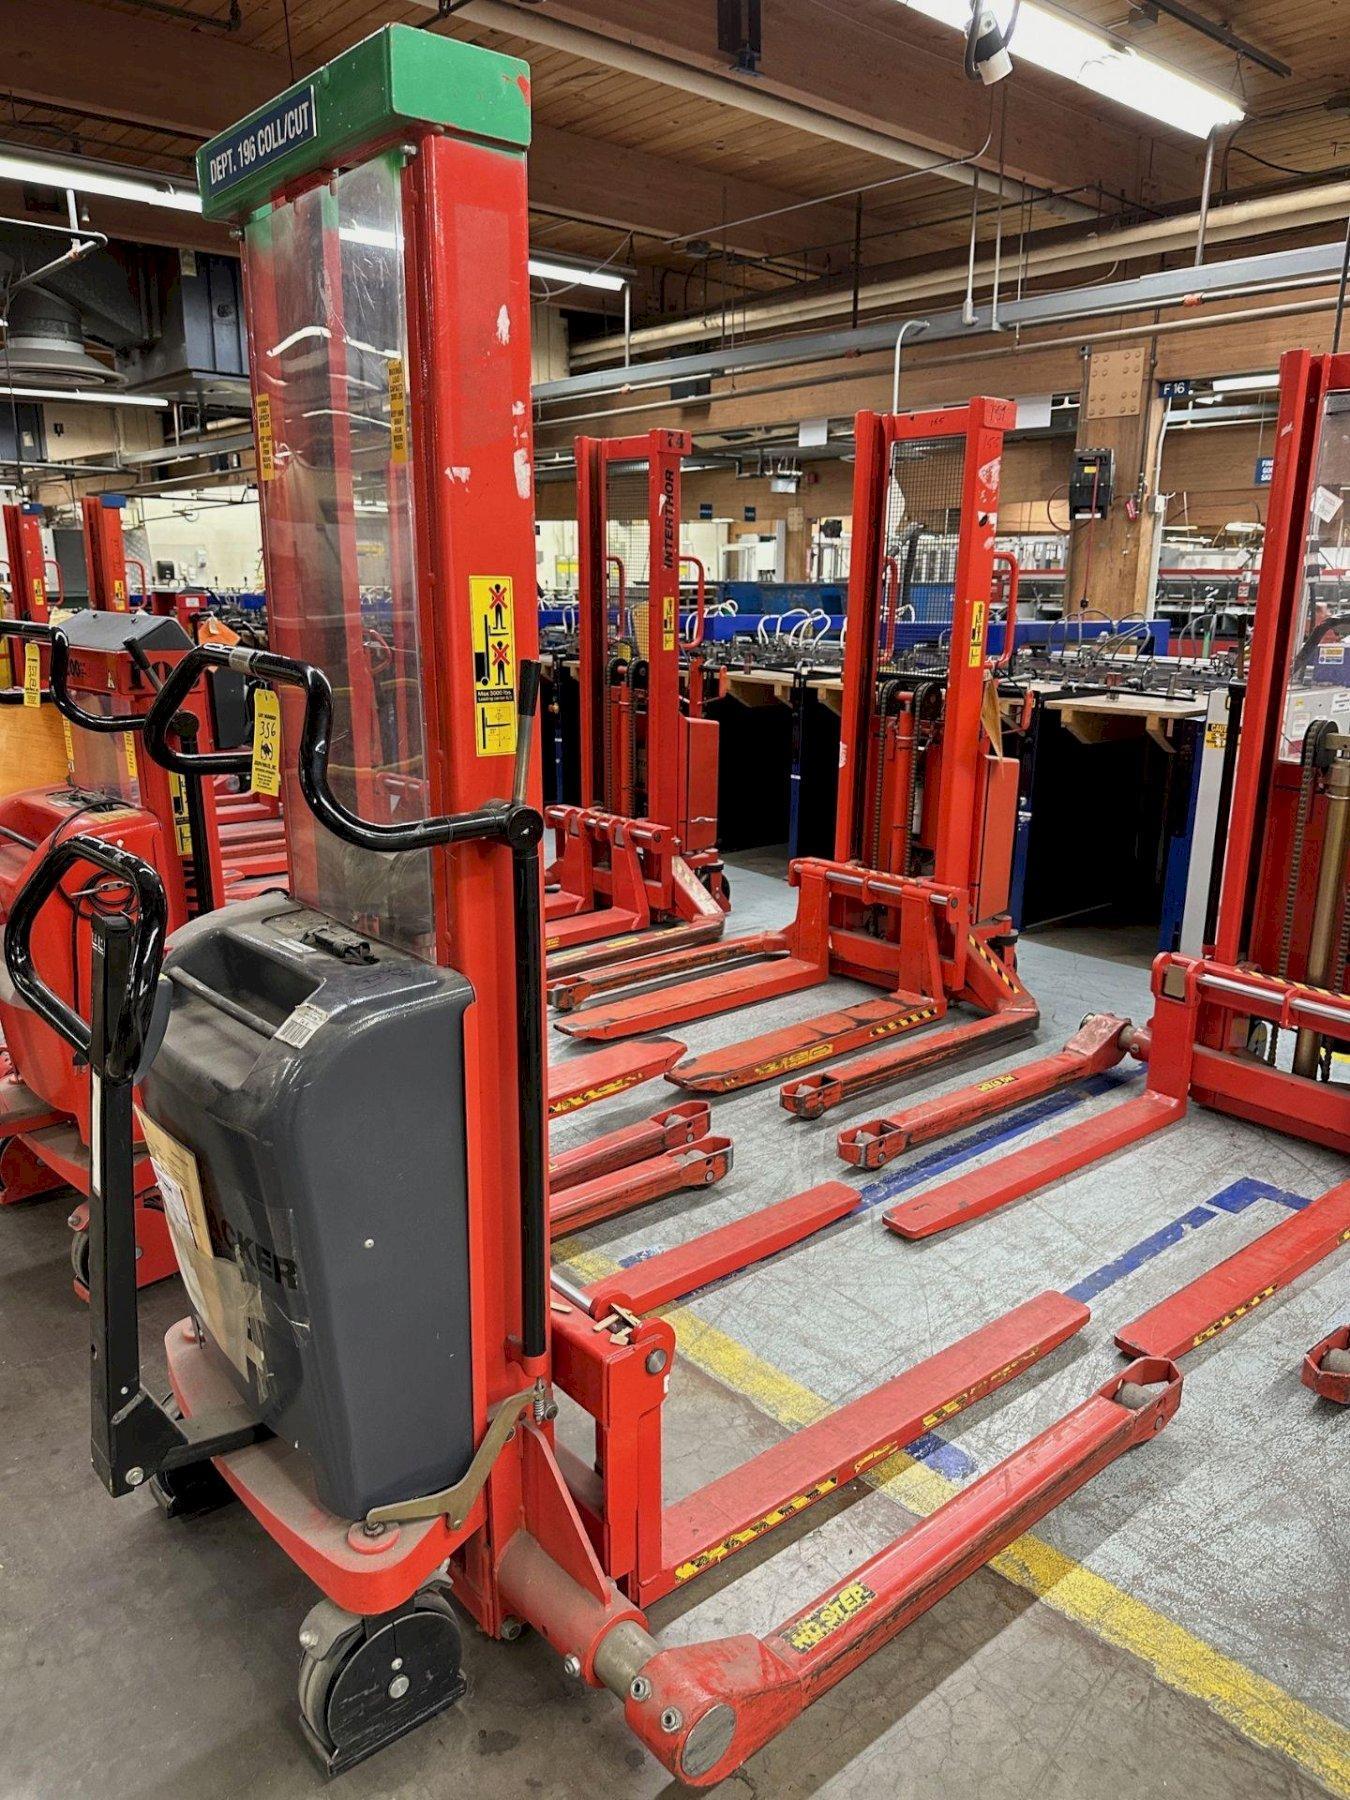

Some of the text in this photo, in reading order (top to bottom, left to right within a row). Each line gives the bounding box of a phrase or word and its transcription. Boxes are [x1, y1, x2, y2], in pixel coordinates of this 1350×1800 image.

[210, 101, 310, 185] DEPT. 196 COLL/CUT
[1163, 381, 1186, 395] F 16
[663, 469, 675, 569] INTERTHOR
[820, 1583, 865, 1629] STEP
